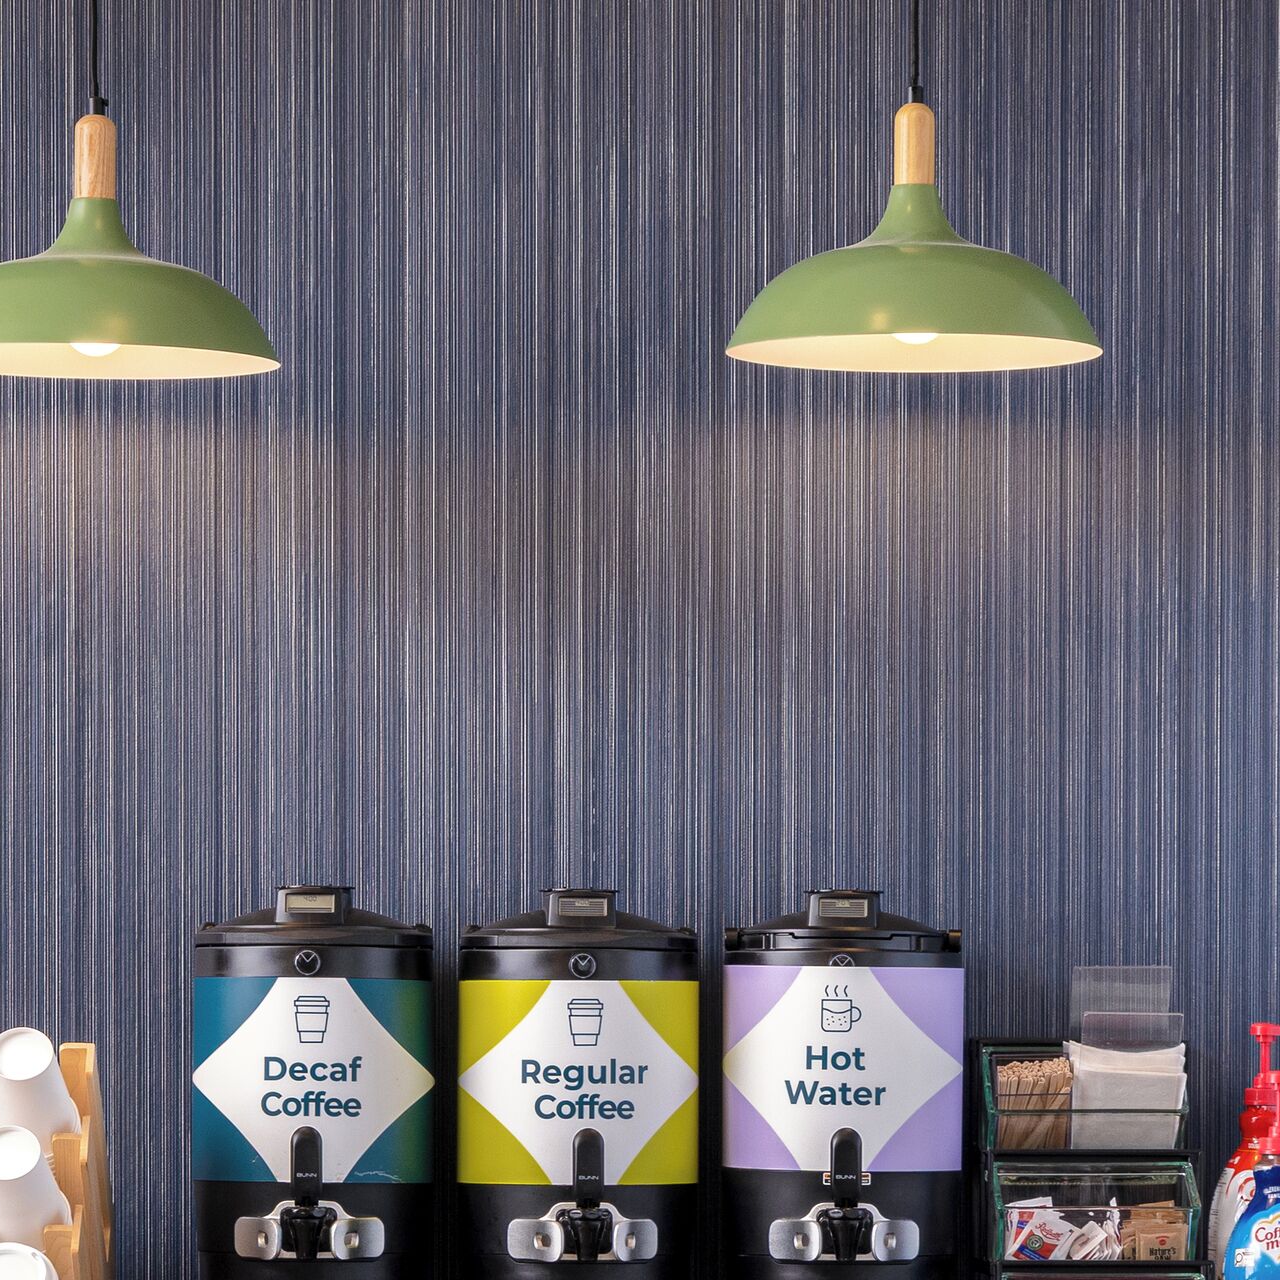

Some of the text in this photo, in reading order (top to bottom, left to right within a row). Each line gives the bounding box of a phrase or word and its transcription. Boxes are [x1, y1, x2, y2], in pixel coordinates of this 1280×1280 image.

[263, 1056, 363, 1082] Decaf
[805, 1045, 866, 1070] Hot
[521, 1058, 648, 1091] Regular
[261, 1091, 362, 1117] Coffee
[784, 1080, 886, 1106] Water
[534, 1093, 635, 1120] Coffee
